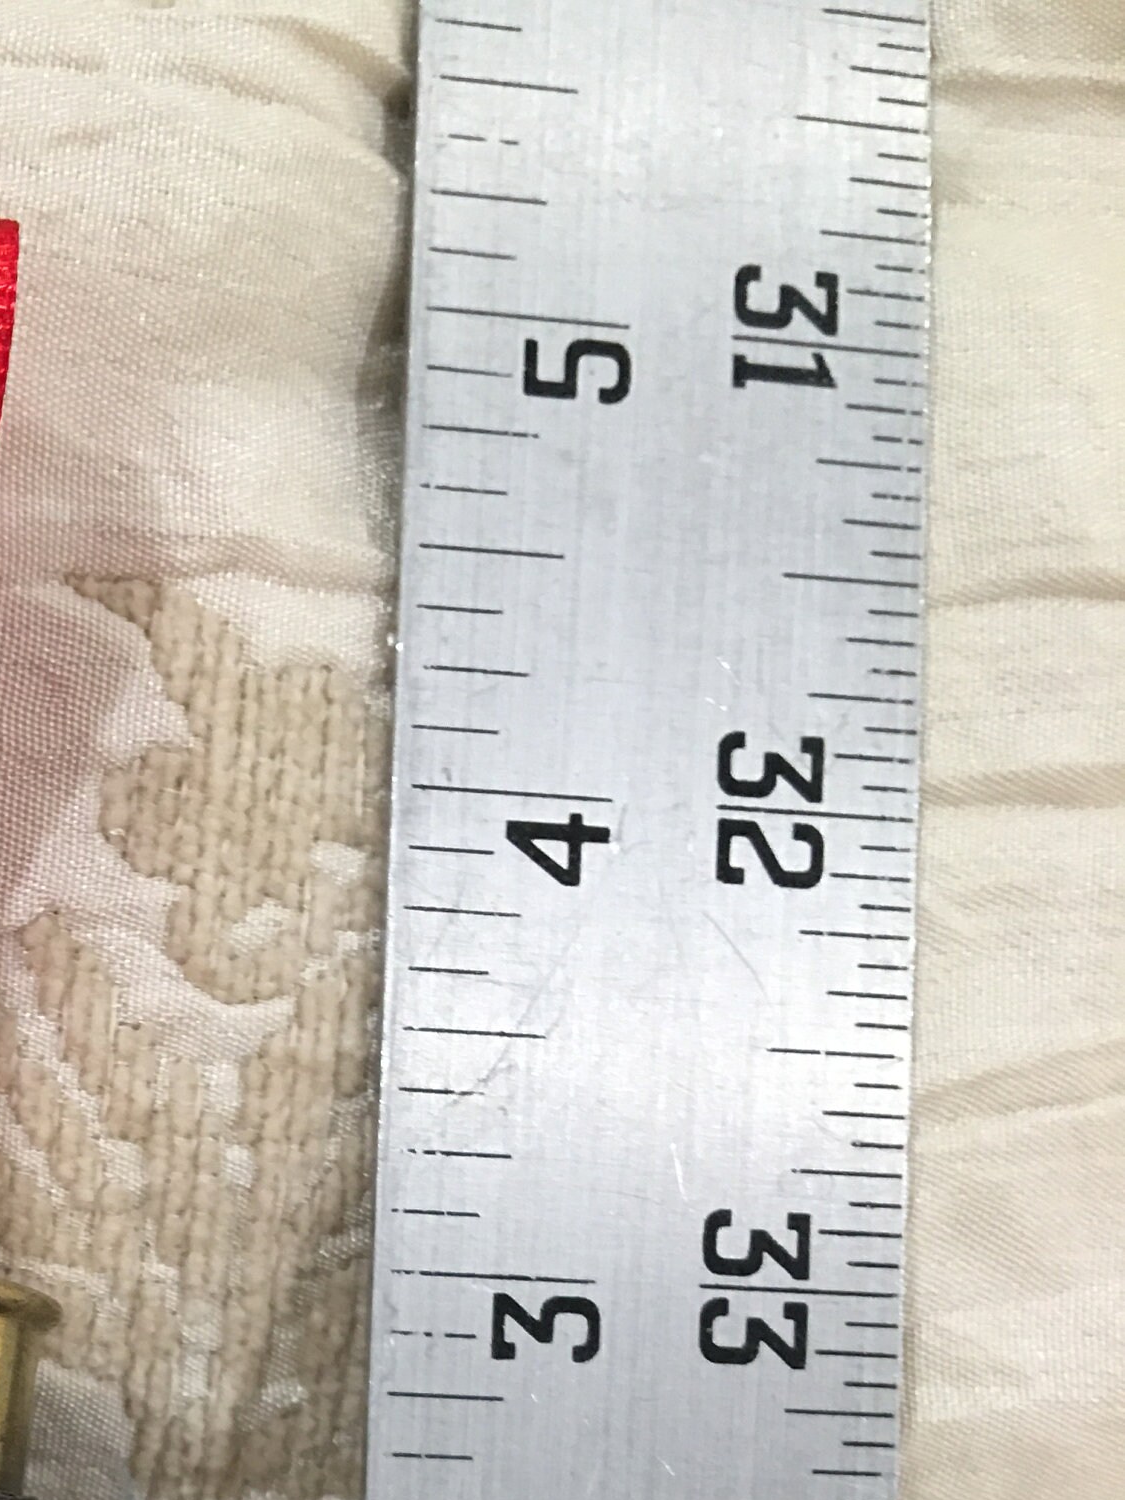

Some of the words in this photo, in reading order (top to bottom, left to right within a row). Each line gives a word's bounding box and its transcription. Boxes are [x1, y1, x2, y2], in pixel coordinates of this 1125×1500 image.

[523, 337, 632, 405] 5
[732, 265, 839, 388] 31
[506, 812, 611, 887] 4
[716, 731, 825, 889] 32
[491, 1291, 601, 1364] 3
[698, 1208, 812, 1370] 33
